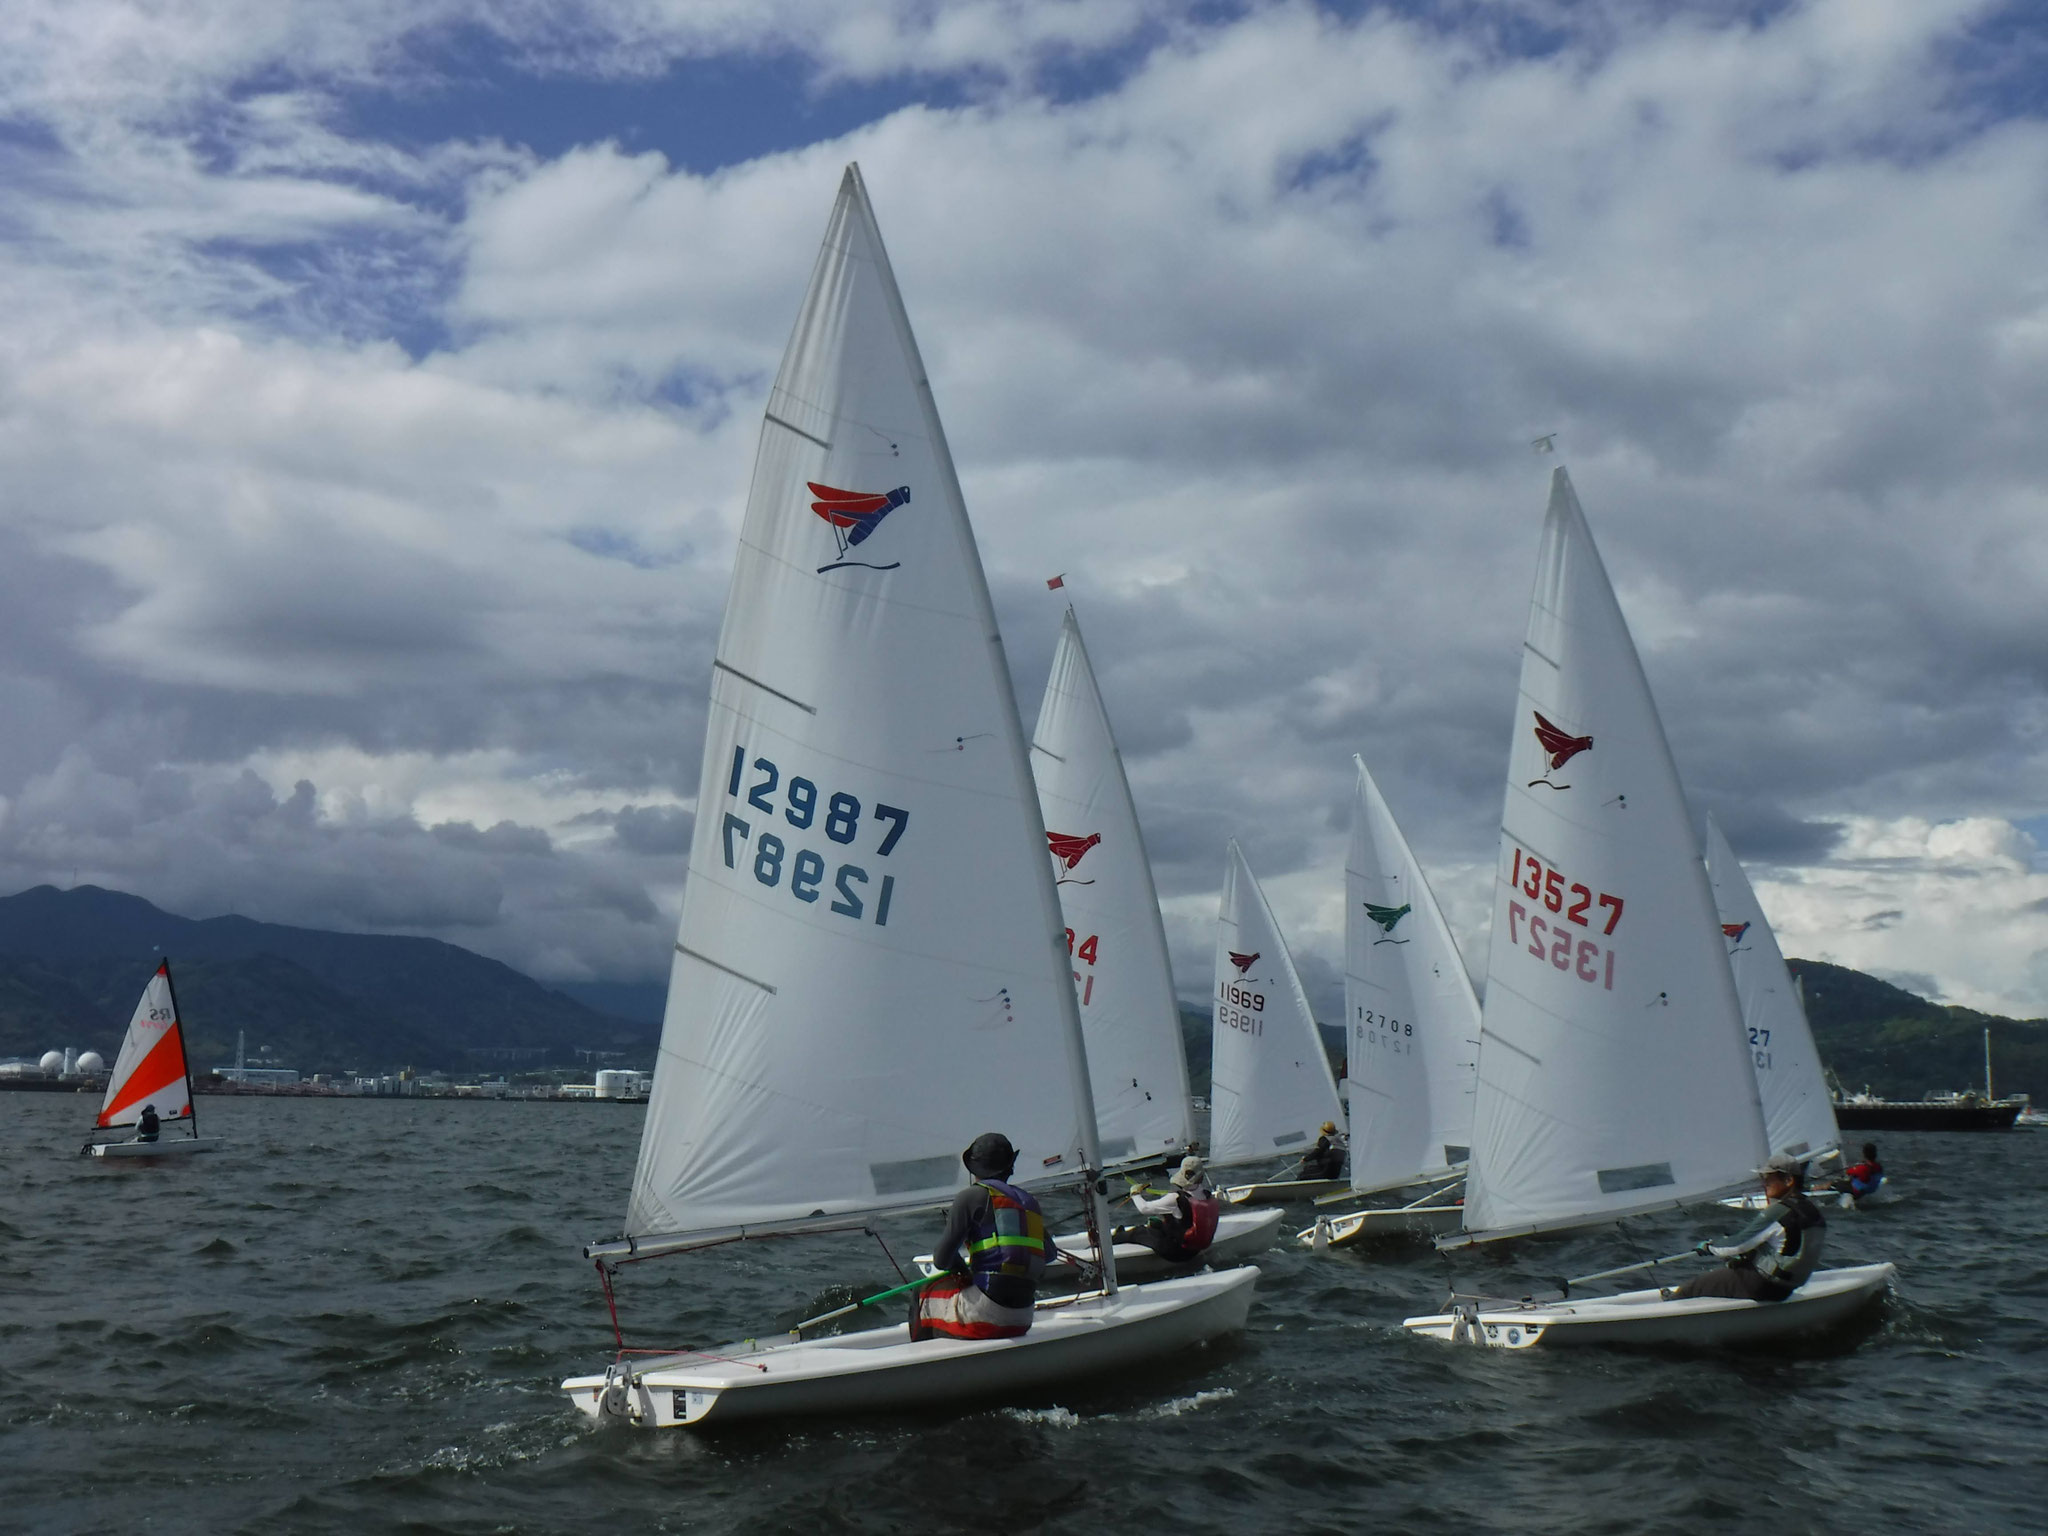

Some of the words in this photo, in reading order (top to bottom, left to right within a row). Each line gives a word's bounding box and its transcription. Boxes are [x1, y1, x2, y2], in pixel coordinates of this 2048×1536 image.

[728, 745, 909, 857] 12987
[1512, 848, 1624, 936] 13527
[1221, 982, 1265, 1012] 11969
[1358, 1006, 1412, 1037] 12708
[1749, 1027, 1770, 1047] 27
